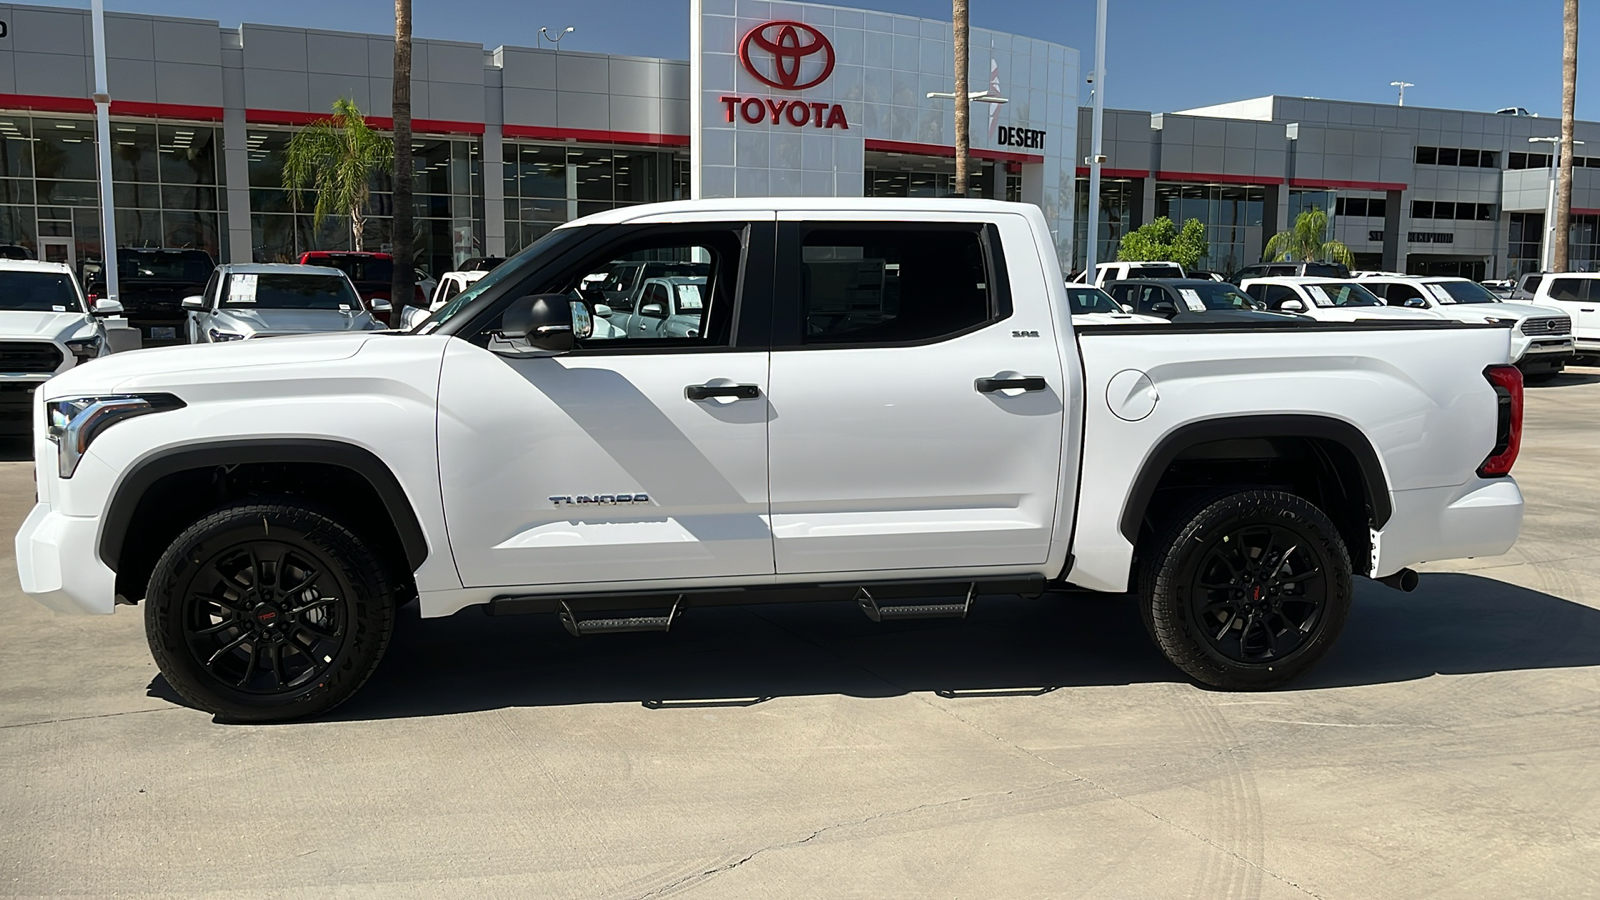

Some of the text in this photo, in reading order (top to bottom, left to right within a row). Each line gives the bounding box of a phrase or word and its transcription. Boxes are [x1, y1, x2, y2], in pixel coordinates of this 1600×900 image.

[719, 95, 849, 130] TOYOTA
[998, 125, 1047, 150] DESERT
[547, 493, 650, 507] TUNDRA
